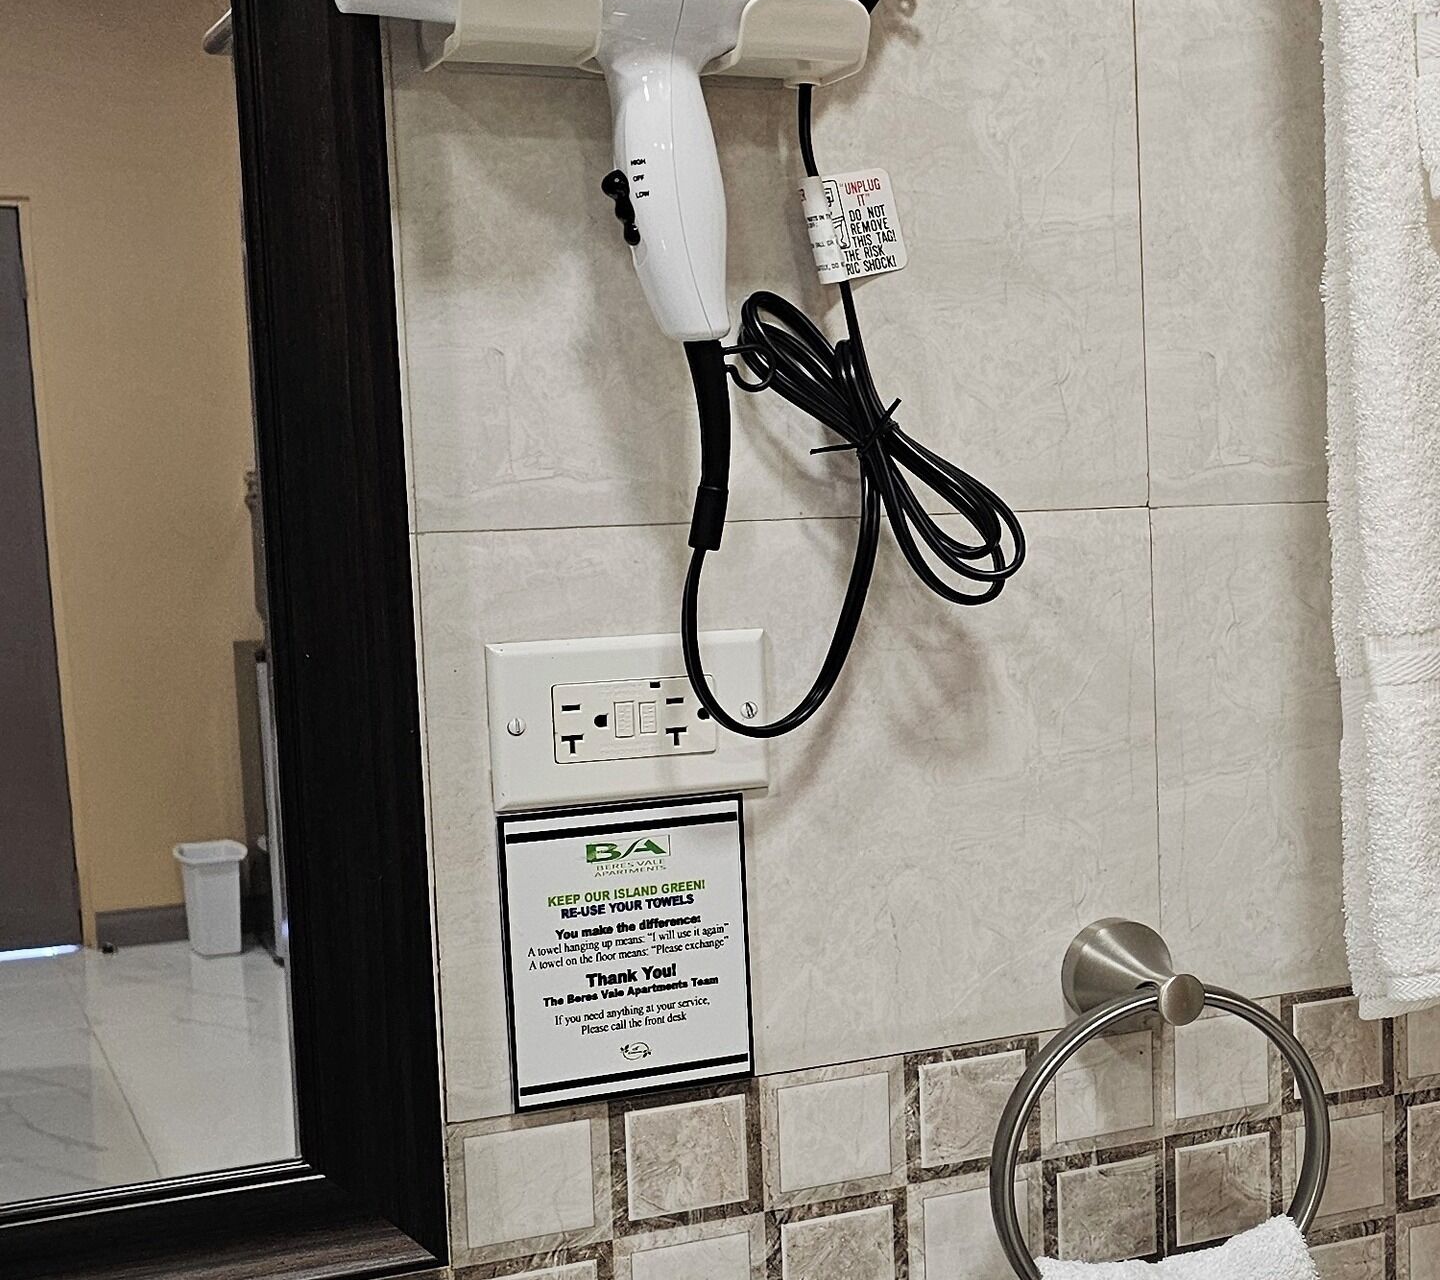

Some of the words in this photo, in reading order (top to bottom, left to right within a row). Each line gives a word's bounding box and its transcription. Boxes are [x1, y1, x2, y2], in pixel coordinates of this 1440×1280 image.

[632, 174, 645, 182] OFF
[635, 190, 650, 199] LOW
[848, 208, 863, 222] DO
[866, 204, 886, 219] NOT
[850, 217, 890, 236] REMOVE
[851, 233, 873, 248] THIS
[876, 229, 898, 244] TAG!
[844, 248, 862, 262] THE
[863, 244, 886, 259] RISK
[863, 255, 898, 272] SHOCK!
[548, 894, 580, 907] KEEP
[584, 890, 610, 903] OUR
[614, 885, 658, 899] ISLAND
[662, 879, 705, 894] GREEN!
[561, 904, 606, 919] RE-USE
[610, 900, 643, 914] YOUR
[646, 894, 694, 909] TOWELS
[527, 947, 536, 957] A
[538, 942, 562, 956] towel
[564, 939, 600, 954] hanging
[601, 939, 613, 949] up
[615, 935, 645, 947] means:
[658, 929, 675, 940] will
[677, 928, 692, 938] use
[693, 926, 700, 936] it
[555, 928, 579, 941] You
[582, 925, 613, 937] make
[616, 922, 636, 934] the
[529, 961, 537, 971] A
[539, 955, 564, 970] towel
[565, 957, 578, 966] on
[579, 953, 593, 964] the
[595, 951, 616, 962] floor
[618, 948, 649, 959] means:
[586, 969, 638, 988] Thank
[641, 963, 677, 981] You!
[543, 995, 564, 1007] The
[567, 993, 598, 1004] Beres
[601, 988, 625, 1000] Vale
[627, 980, 688, 997] Apartments
[691, 976, 719, 987] Team
[555, 1015, 564, 1026] If
[564, 1015, 581, 1026] you
[584, 1010, 604, 1022] need
[606, 1005, 644, 1019] anything
[645, 1004, 655, 1013] at
[656, 1002, 676, 1014] your
[581, 1024, 609, 1035] Please
[611, 1020, 626, 1031] call
[629, 1017, 643, 1029] the
[645, 1014, 665, 1026] front
[667, 1011, 687, 1023] desk
